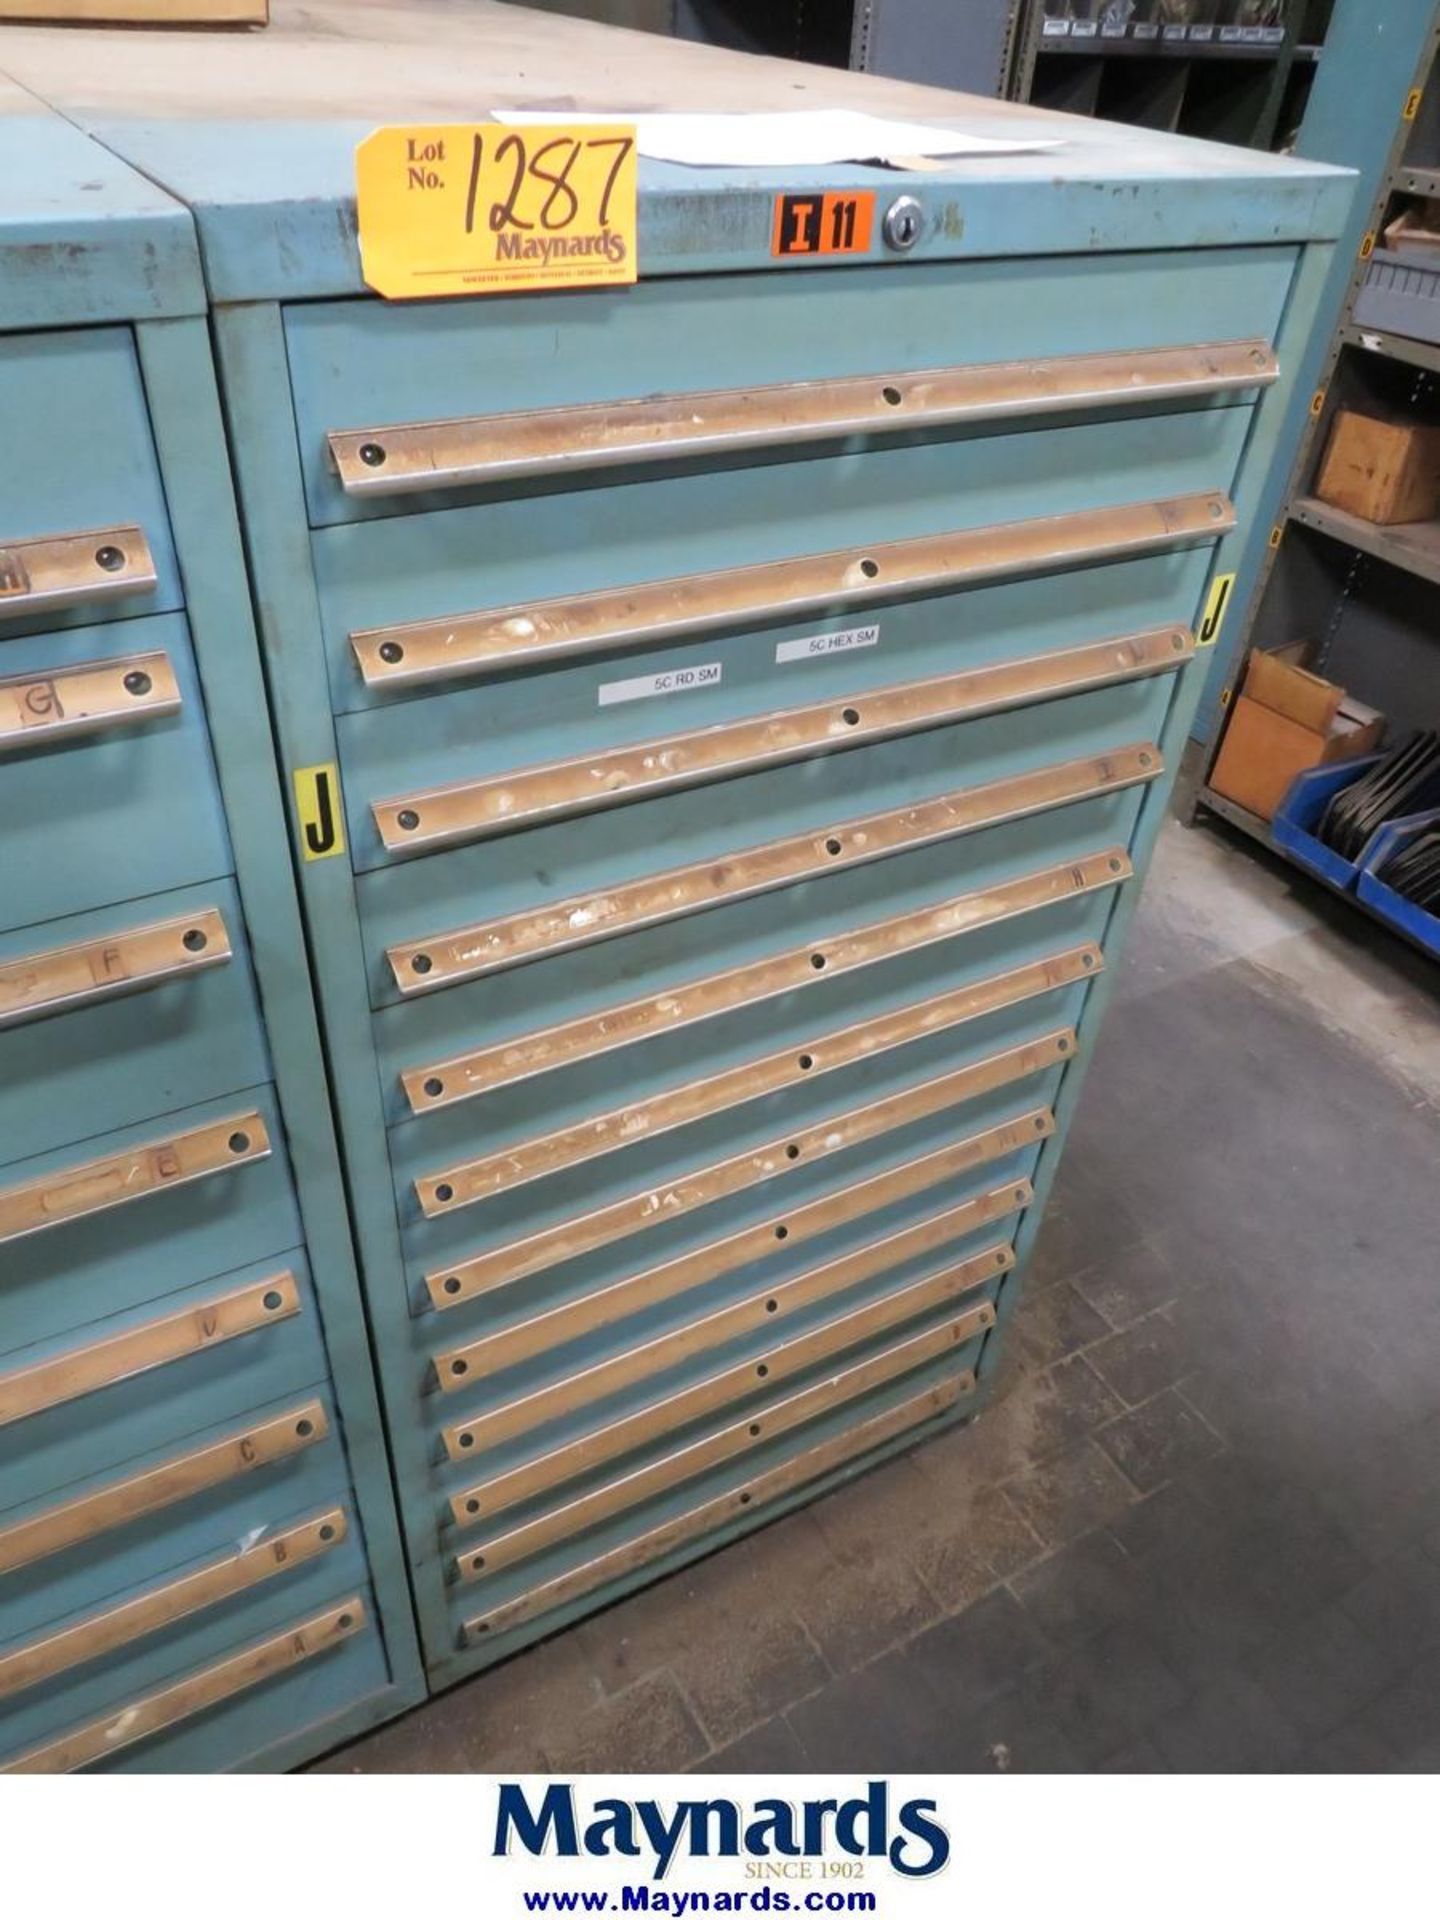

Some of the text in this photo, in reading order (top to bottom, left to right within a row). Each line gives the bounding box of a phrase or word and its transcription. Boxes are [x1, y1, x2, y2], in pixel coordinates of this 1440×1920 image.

[407, 138, 445, 162] Lot
[407, 167, 445, 191] No.
[465, 132, 634, 235] 1287
[831, 199, 857, 249] 11
[495, 228, 626, 267] Maynards
[1200, 579, 1230, 643] J
[808, 628, 877, 653] 5C HEX SM
[654, 666, 719, 691] 5C RD SM
[305, 771, 335, 854] J
[240, 1438, 255, 1462] C
